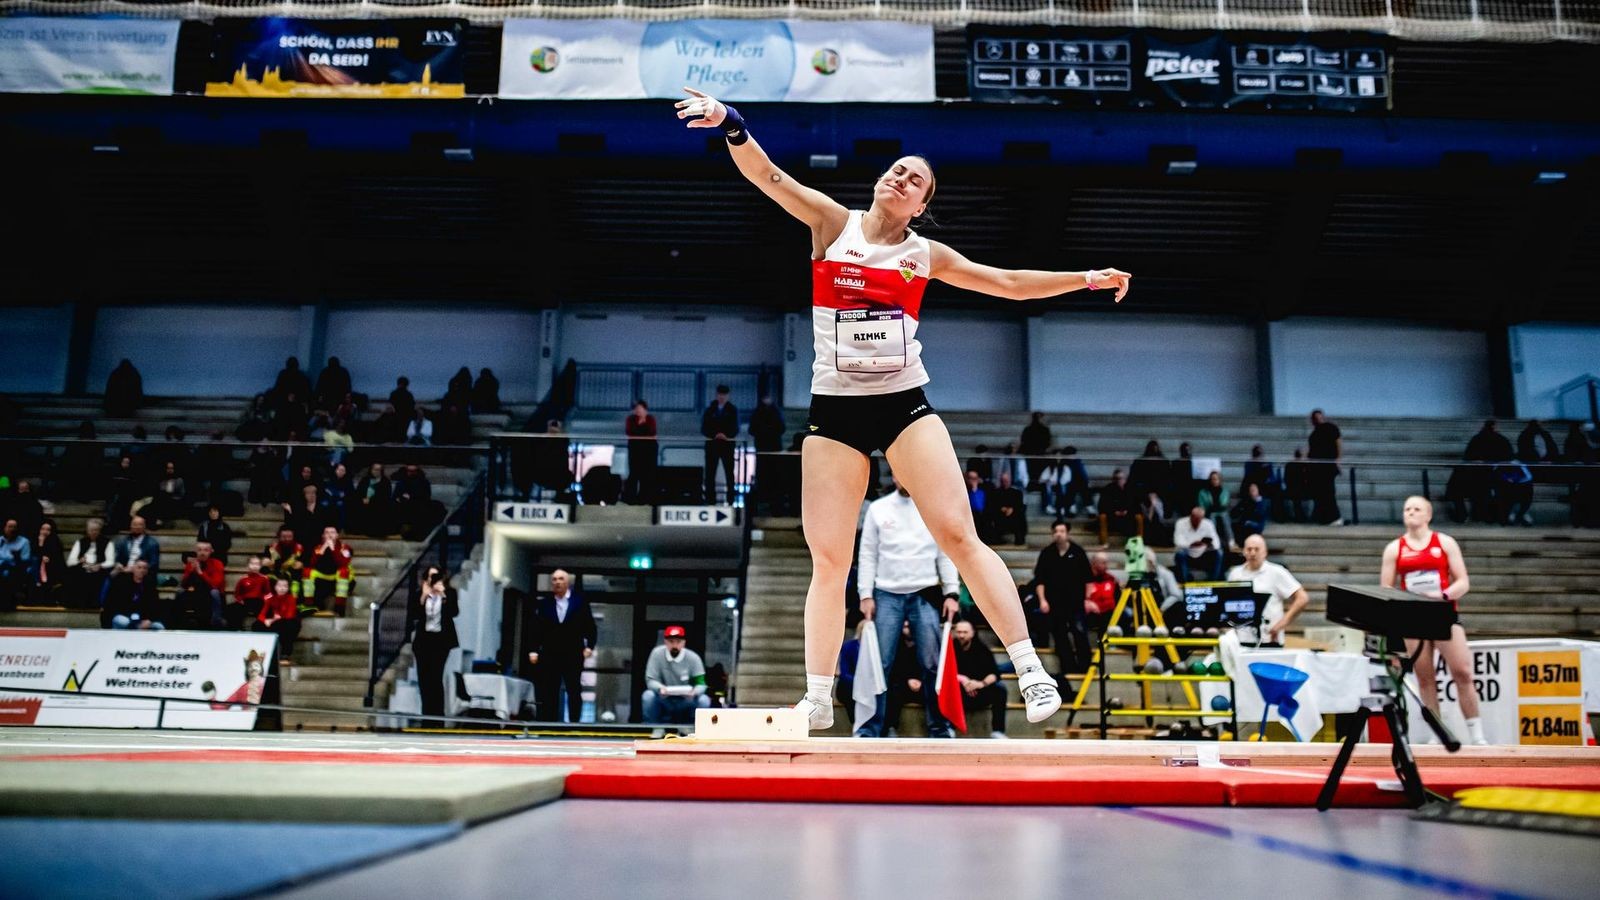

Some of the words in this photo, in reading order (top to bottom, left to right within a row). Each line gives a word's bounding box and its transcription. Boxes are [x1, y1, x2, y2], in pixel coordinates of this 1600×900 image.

[50, 28, 168, 44] Verantwortung
[279, 35, 333, 50] SCHÖN,
[336, 37, 374, 49] DASS
[375, 37, 399, 49] IHR
[674, 39, 708, 57] Wir
[713, 41, 764, 58] leben
[308, 53, 330, 66] DA
[332, 54, 370, 66] SEID!
[1144, 54, 1221, 77] peter
[686, 64, 748, 86] Pflege.
[845, 249, 865, 258] JAKO
[834, 277, 866, 288] HABAU
[853, 332, 887, 341] RIMKE
[520, 508, 547, 519] BLOCK
[554, 509, 564, 520] A
[665, 511, 691, 521] BLOCK
[698, 511, 709, 522] C
[114, 650, 200, 661] Nordhausen
[117, 665, 164, 675] macht
[167, 665, 189, 675] die
[1434, 652, 1500, 675] AEN
[1519, 664, 1579, 684] 19,57m
[105, 678, 193, 690] Weltmeister
[1435, 679, 1500, 702] ECRD
[1520, 717, 1579, 737] 21,84m
